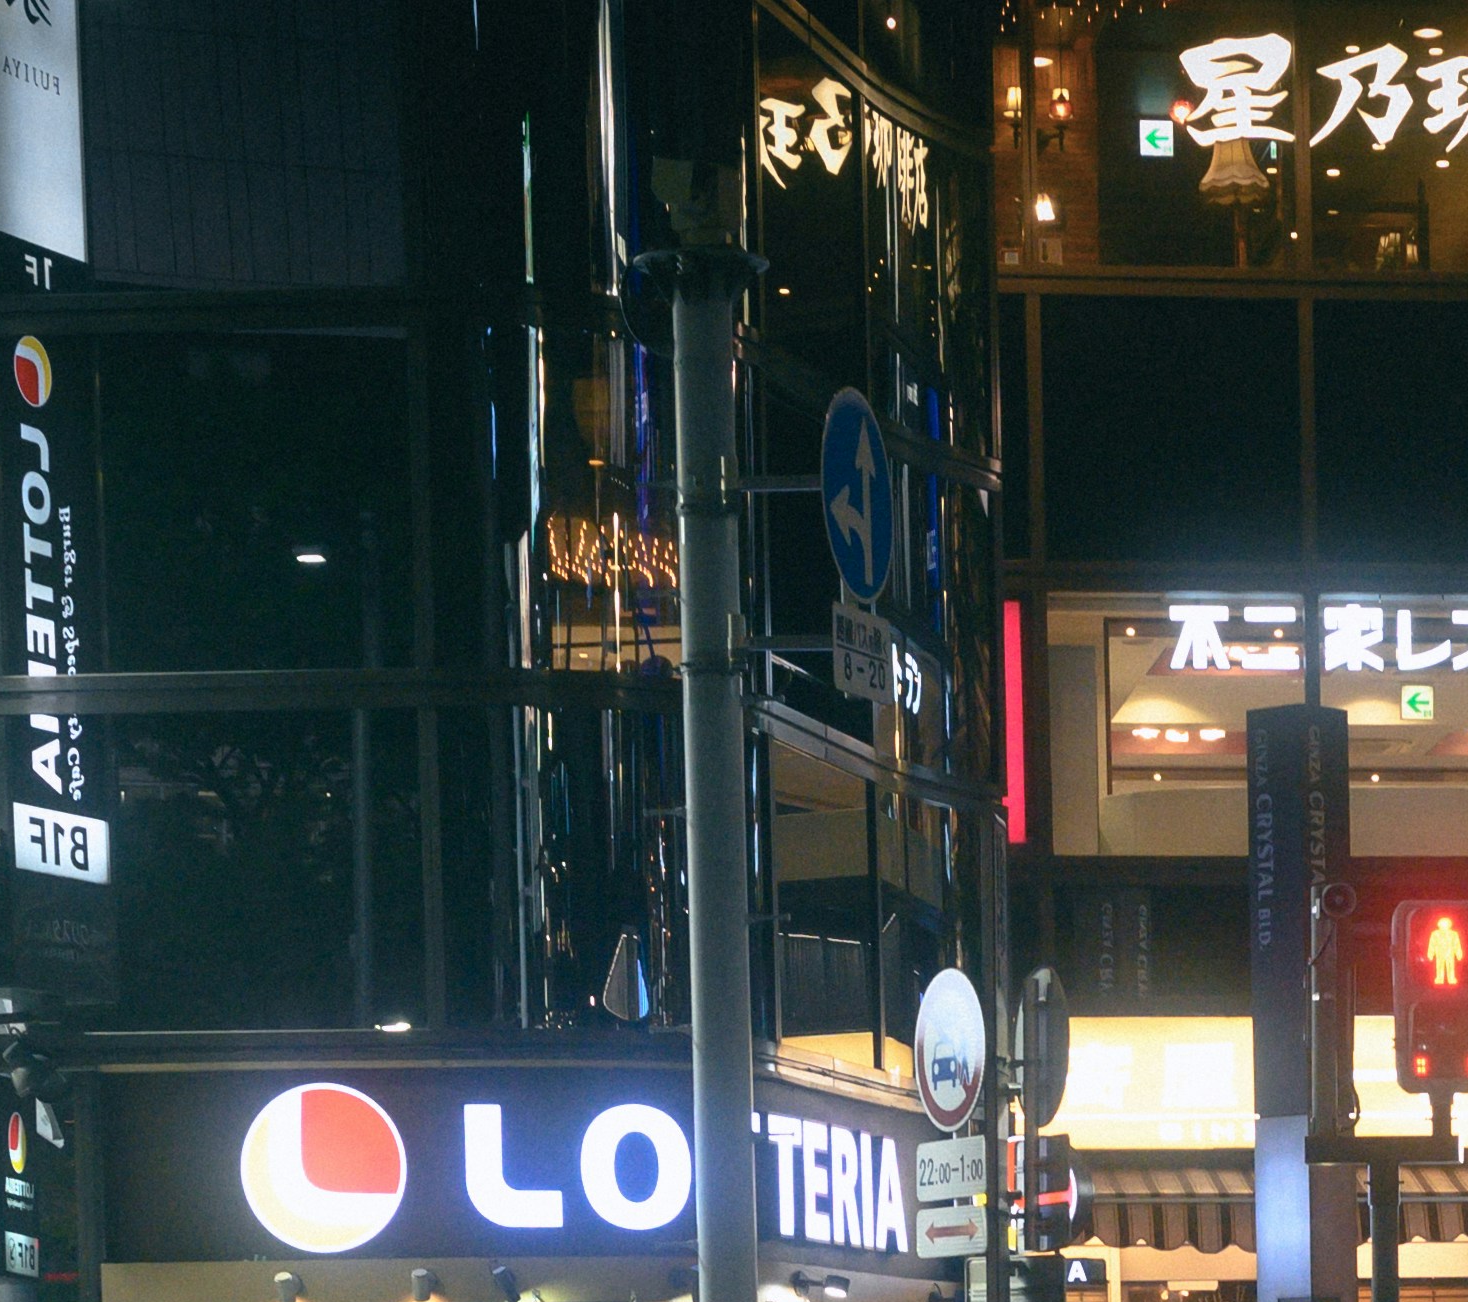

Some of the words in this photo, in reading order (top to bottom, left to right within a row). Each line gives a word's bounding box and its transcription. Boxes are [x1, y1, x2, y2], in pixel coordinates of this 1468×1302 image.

[1255, 793, 1274, 902] CRYSTAL
[1308, 790, 1326, 885] CRYSTA
[464, 1103, 909, 1253] LOTERIA
[919, 1153, 984, 1188] 22:00-1:00
